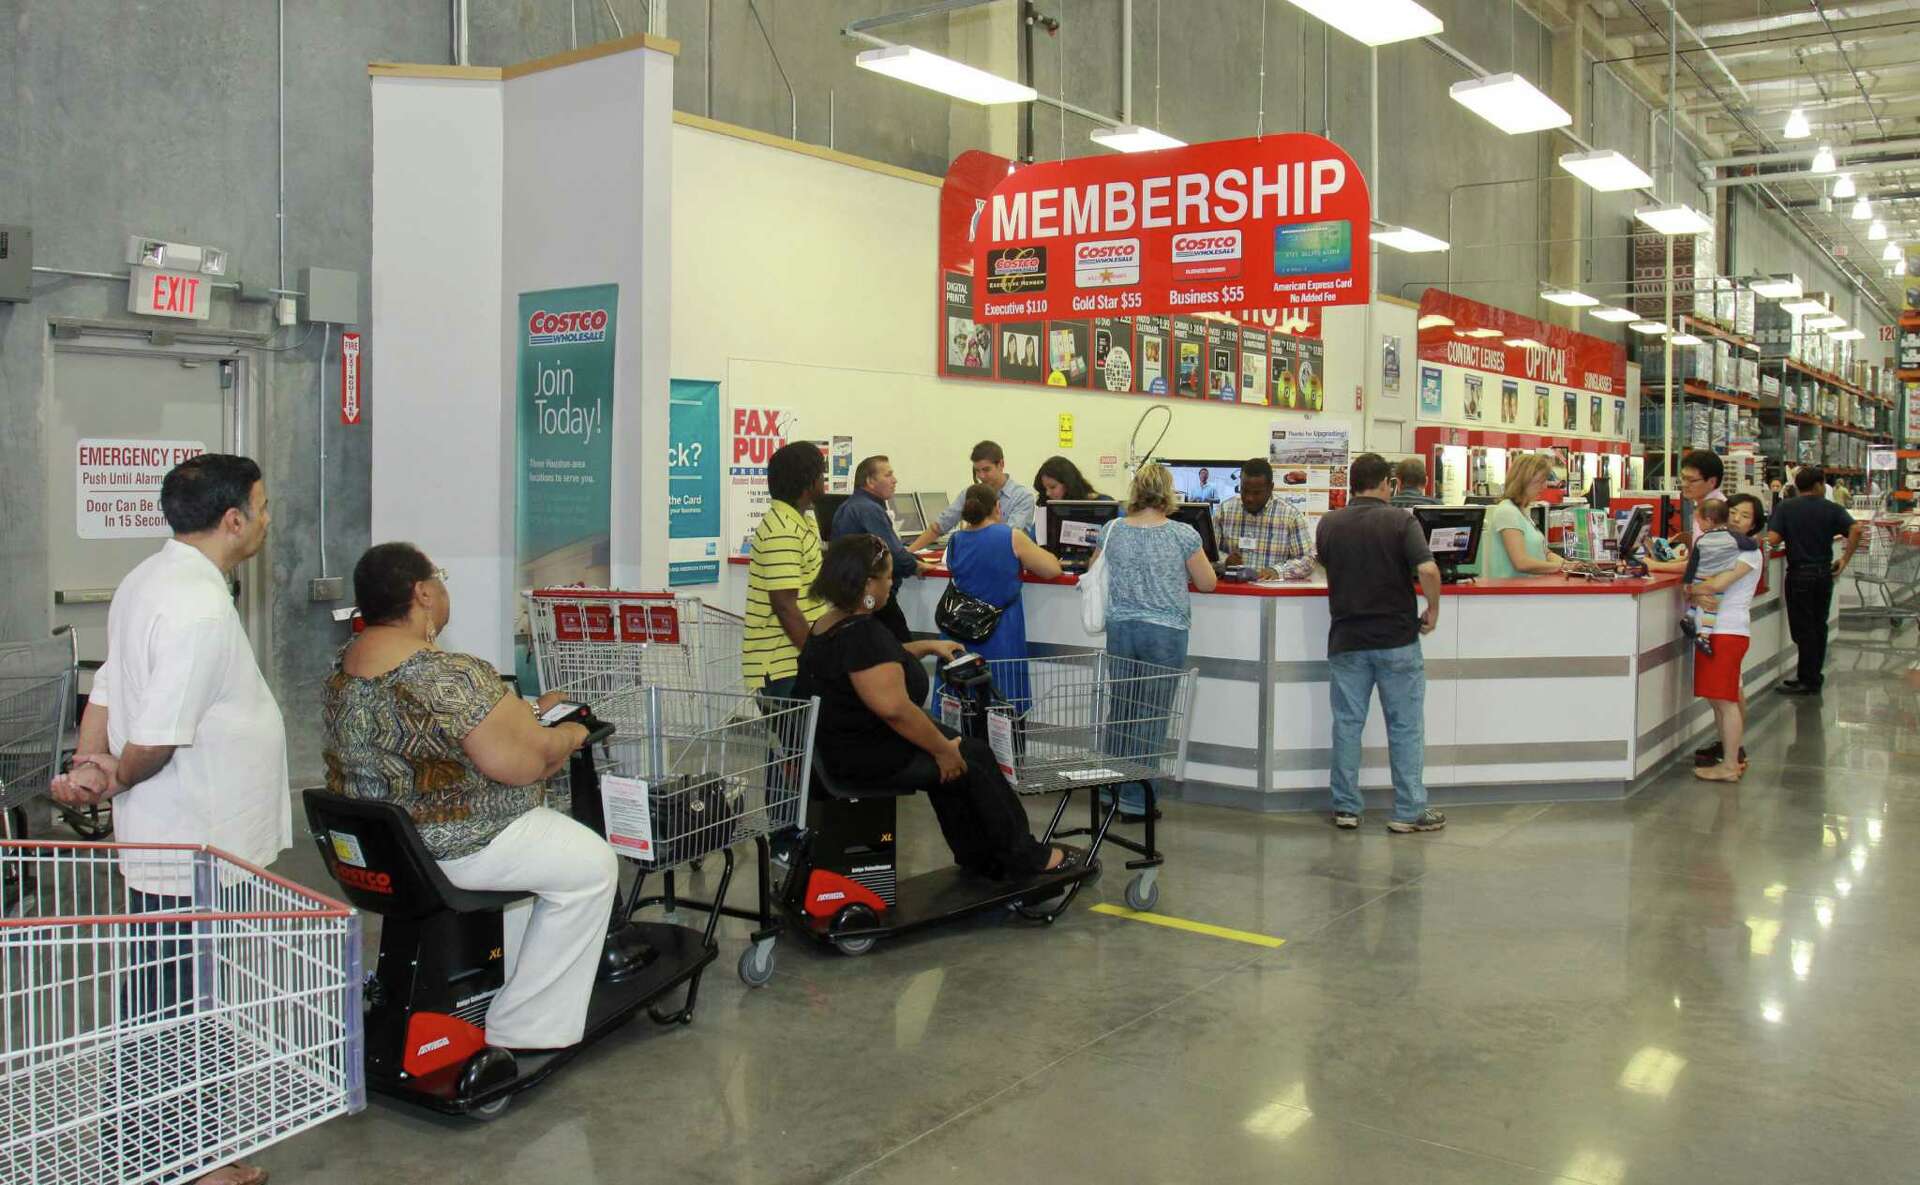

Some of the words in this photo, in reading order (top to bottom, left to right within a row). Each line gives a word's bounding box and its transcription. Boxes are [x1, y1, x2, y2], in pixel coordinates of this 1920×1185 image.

[992, 158, 1346, 242] MEMBERSHIP
[1079, 245, 1135, 259] COSTCO
[1175, 235, 1236, 252] COSTCO
[946, 281, 968, 294] DIGITAL
[1273, 282, 1306, 292] American
[1307, 281, 1335, 291] Express
[1335, 278, 1353, 288] Card
[153, 275, 199, 313] EXIT
[946, 292, 966, 304] PRINTS
[1072, 295, 1096, 311] Gold
[1097, 294, 1118, 309] Star
[1121, 291, 1142, 310] $55
[1169, 289, 1219, 305] Business
[1221, 285, 1245, 304] $55
[1290, 294, 1300, 303] No
[1301, 292, 1323, 303] Added
[1324, 292, 1337, 302] Fee
[985, 301, 1025, 316] Executive
[1026, 299, 1048, 314] $110
[529, 309, 608, 335] COSTCO
[552, 331, 604, 344] WHOLESALE
[1447, 340, 1480, 367] CONTACT
[1480, 347, 1505, 373] LENSES
[1526, 345, 1568, 384] OPTICAL
[534, 359, 574, 396] Join
[1584, 371, 1612, 392] SUNGLASSES
[534, 396, 601, 445] Today!
[734, 409, 780, 436] FAX
[80, 447, 169, 467] EMERGENCY
[83, 472, 107, 485] Push
[110, 472, 132, 485] Until
[136, 473, 162, 485] Alarm
[87, 500, 112, 512] Door
[116, 500, 136, 512] Can
[140, 500, 153, 512] Be
[669, 495, 681, 505] the
[683, 495, 702, 505] Card
[105, 515, 115, 527] In
[120, 515, 131, 527] 15
[135, 515, 168, 527] Secon
[881, 833, 893, 842] XL
[489, 947, 503, 960] XL
